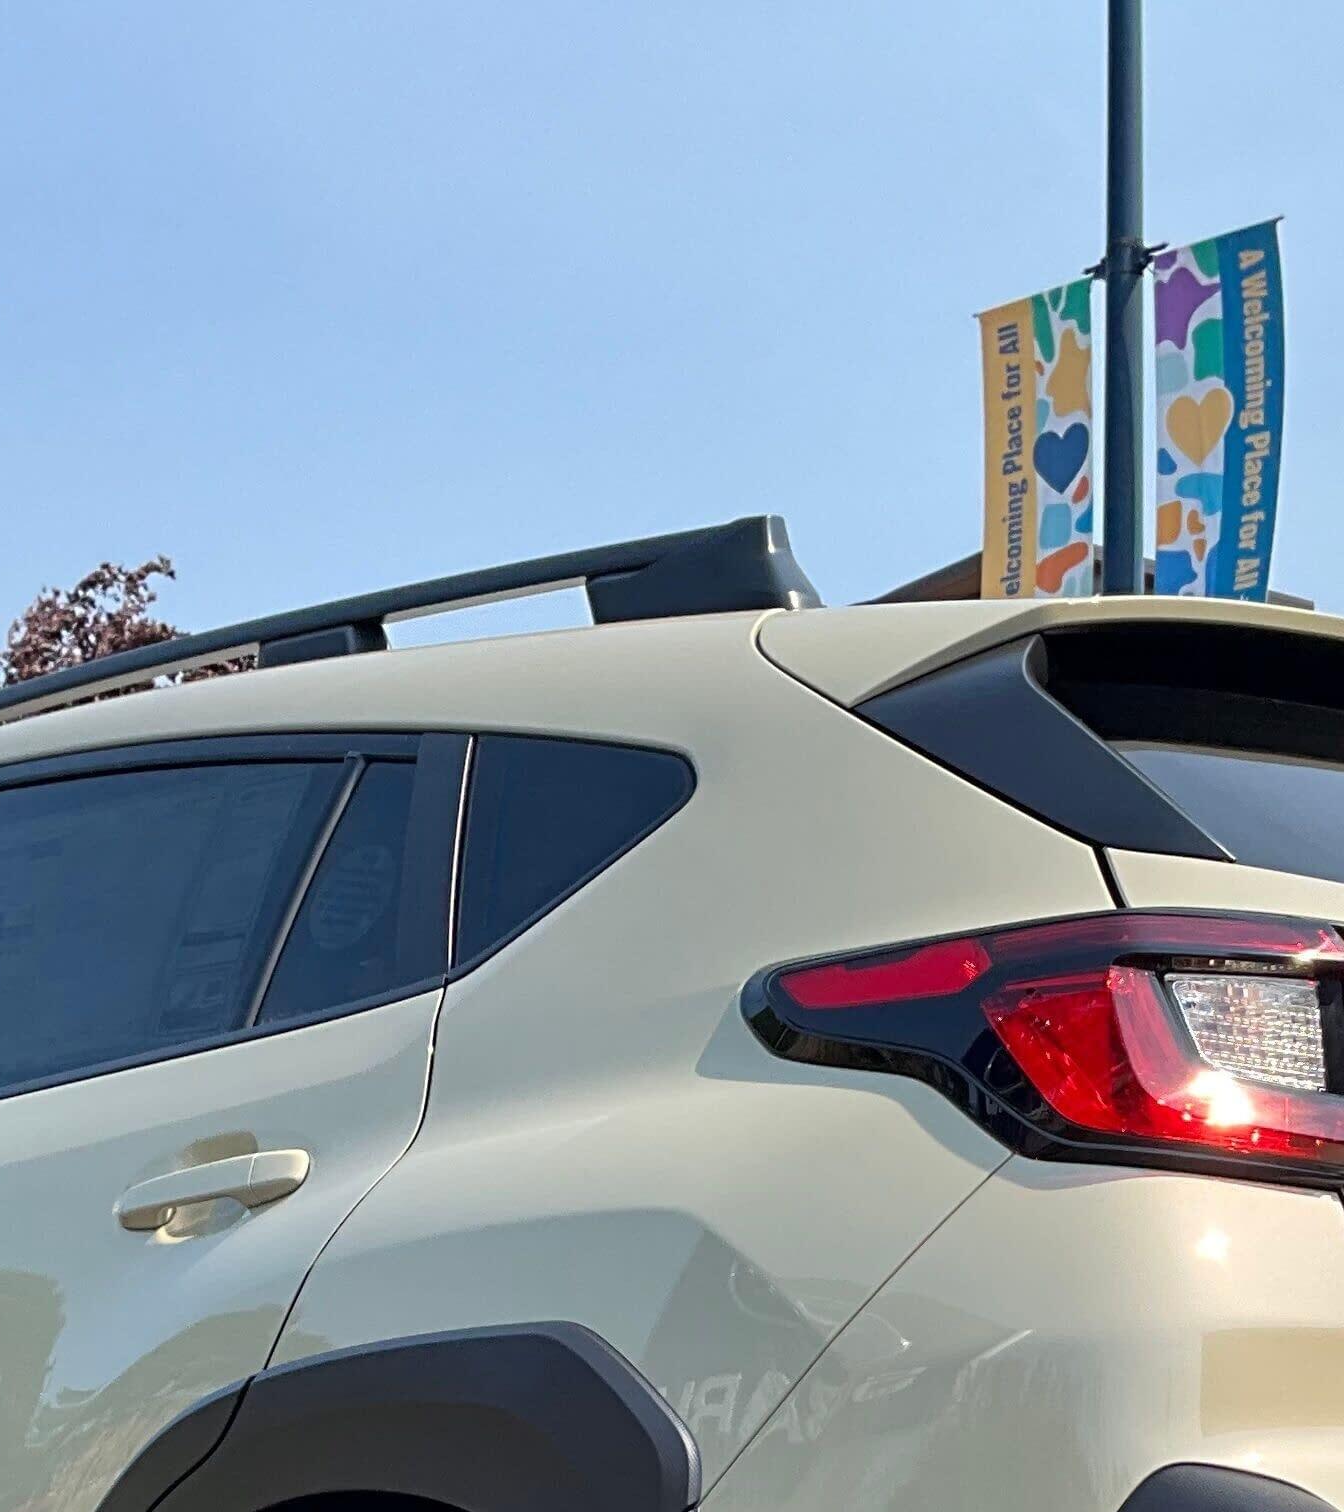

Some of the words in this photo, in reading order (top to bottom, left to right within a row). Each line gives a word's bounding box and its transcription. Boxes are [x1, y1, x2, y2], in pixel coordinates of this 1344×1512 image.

[1238, 248, 1266, 270] A
[998, 322, 1019, 356] All
[1239, 271, 1271, 430] Welcoming
[1001, 362, 1021, 401] for
[1002, 405, 1024, 477] Place
[1242, 430, 1271, 507] Place
[1000, 478, 1028, 596] elcoming
[1238, 511, 1266, 549] for
[1233, 557, 1261, 591] All
